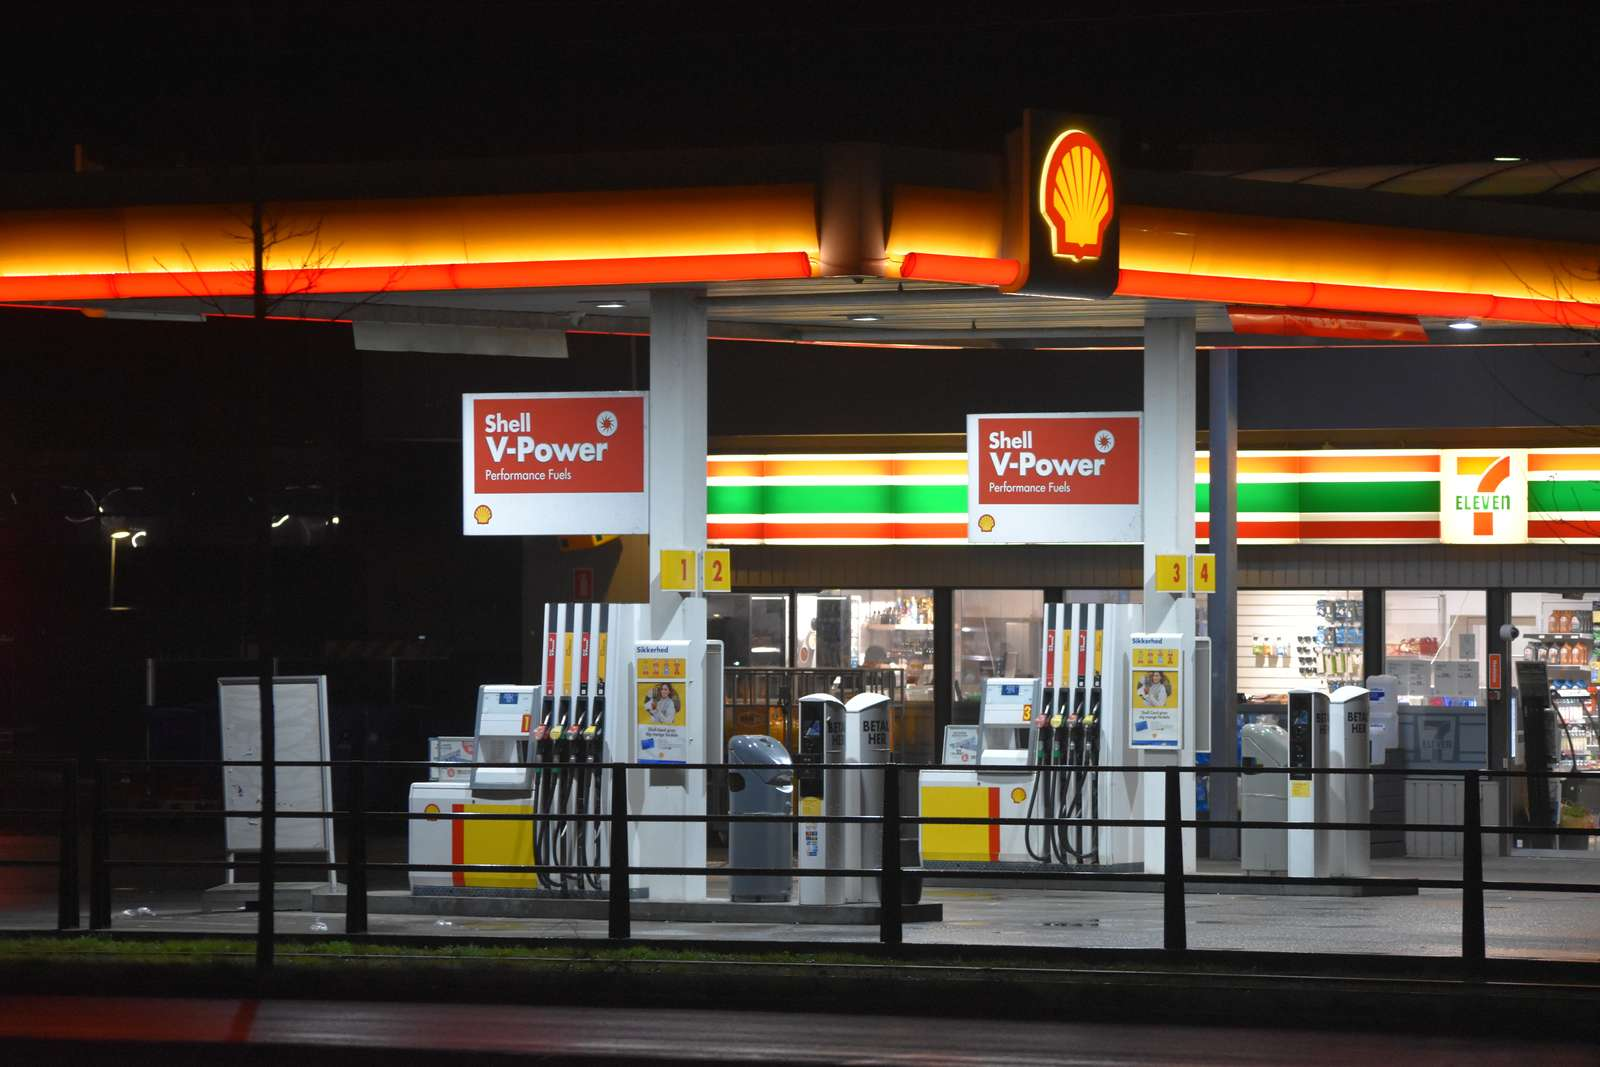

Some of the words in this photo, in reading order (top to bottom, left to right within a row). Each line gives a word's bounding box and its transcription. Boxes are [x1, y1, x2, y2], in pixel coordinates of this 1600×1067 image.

[485, 412, 531, 433] Shell
[486, 436, 608, 463] V-Power
[989, 431, 1032, 449] Shell
[485, 469, 545, 481] Performance
[548, 468, 572, 481] Fuels
[989, 452, 1106, 477] V-Power
[989, 482, 1046, 493] Performance
[1048, 481, 1071, 493] Fuels
[680, 559, 687, 581] 1
[712, 560, 722, 582] 2
[1172, 562, 1181, 583] 3
[1200, 562, 1209, 583] 4
[636, 646, 669, 654] Sikkerhed
[1023, 705, 1031, 721] 3
